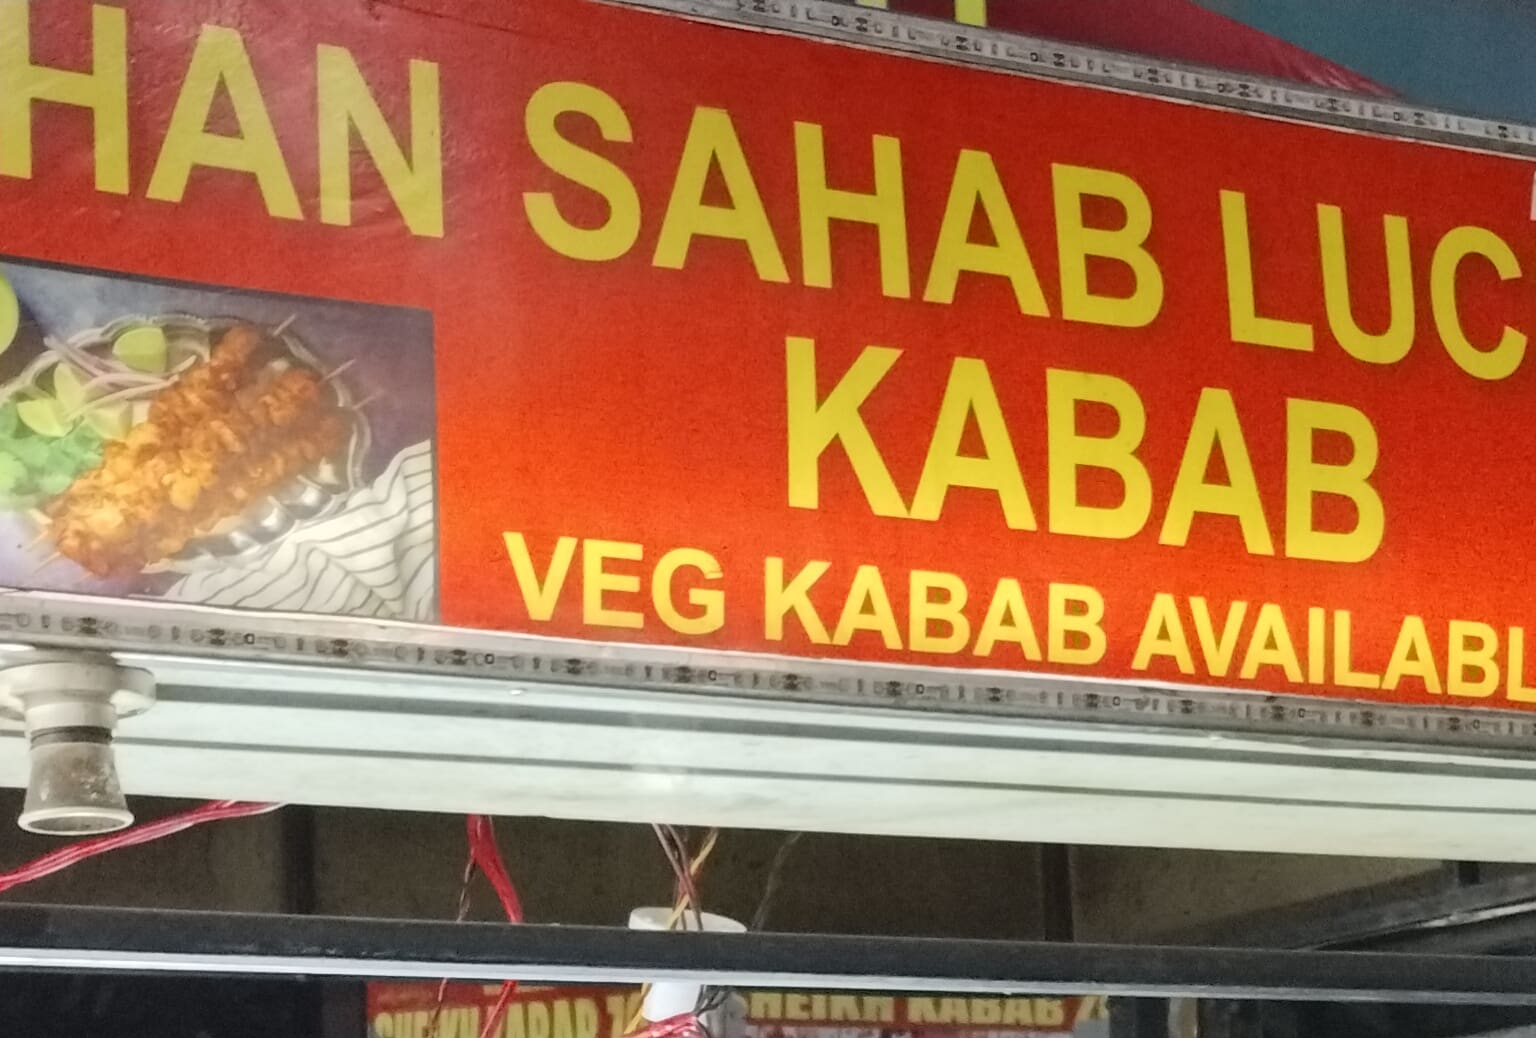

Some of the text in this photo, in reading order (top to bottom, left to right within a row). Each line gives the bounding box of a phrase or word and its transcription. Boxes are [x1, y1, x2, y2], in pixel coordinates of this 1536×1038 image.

[522, 80, 1164, 329] SAHAB
[786, 334, 1387, 564] KABAB
[502, 528, 726, 637] VEG
[762, 554, 1109, 667] KABAB
